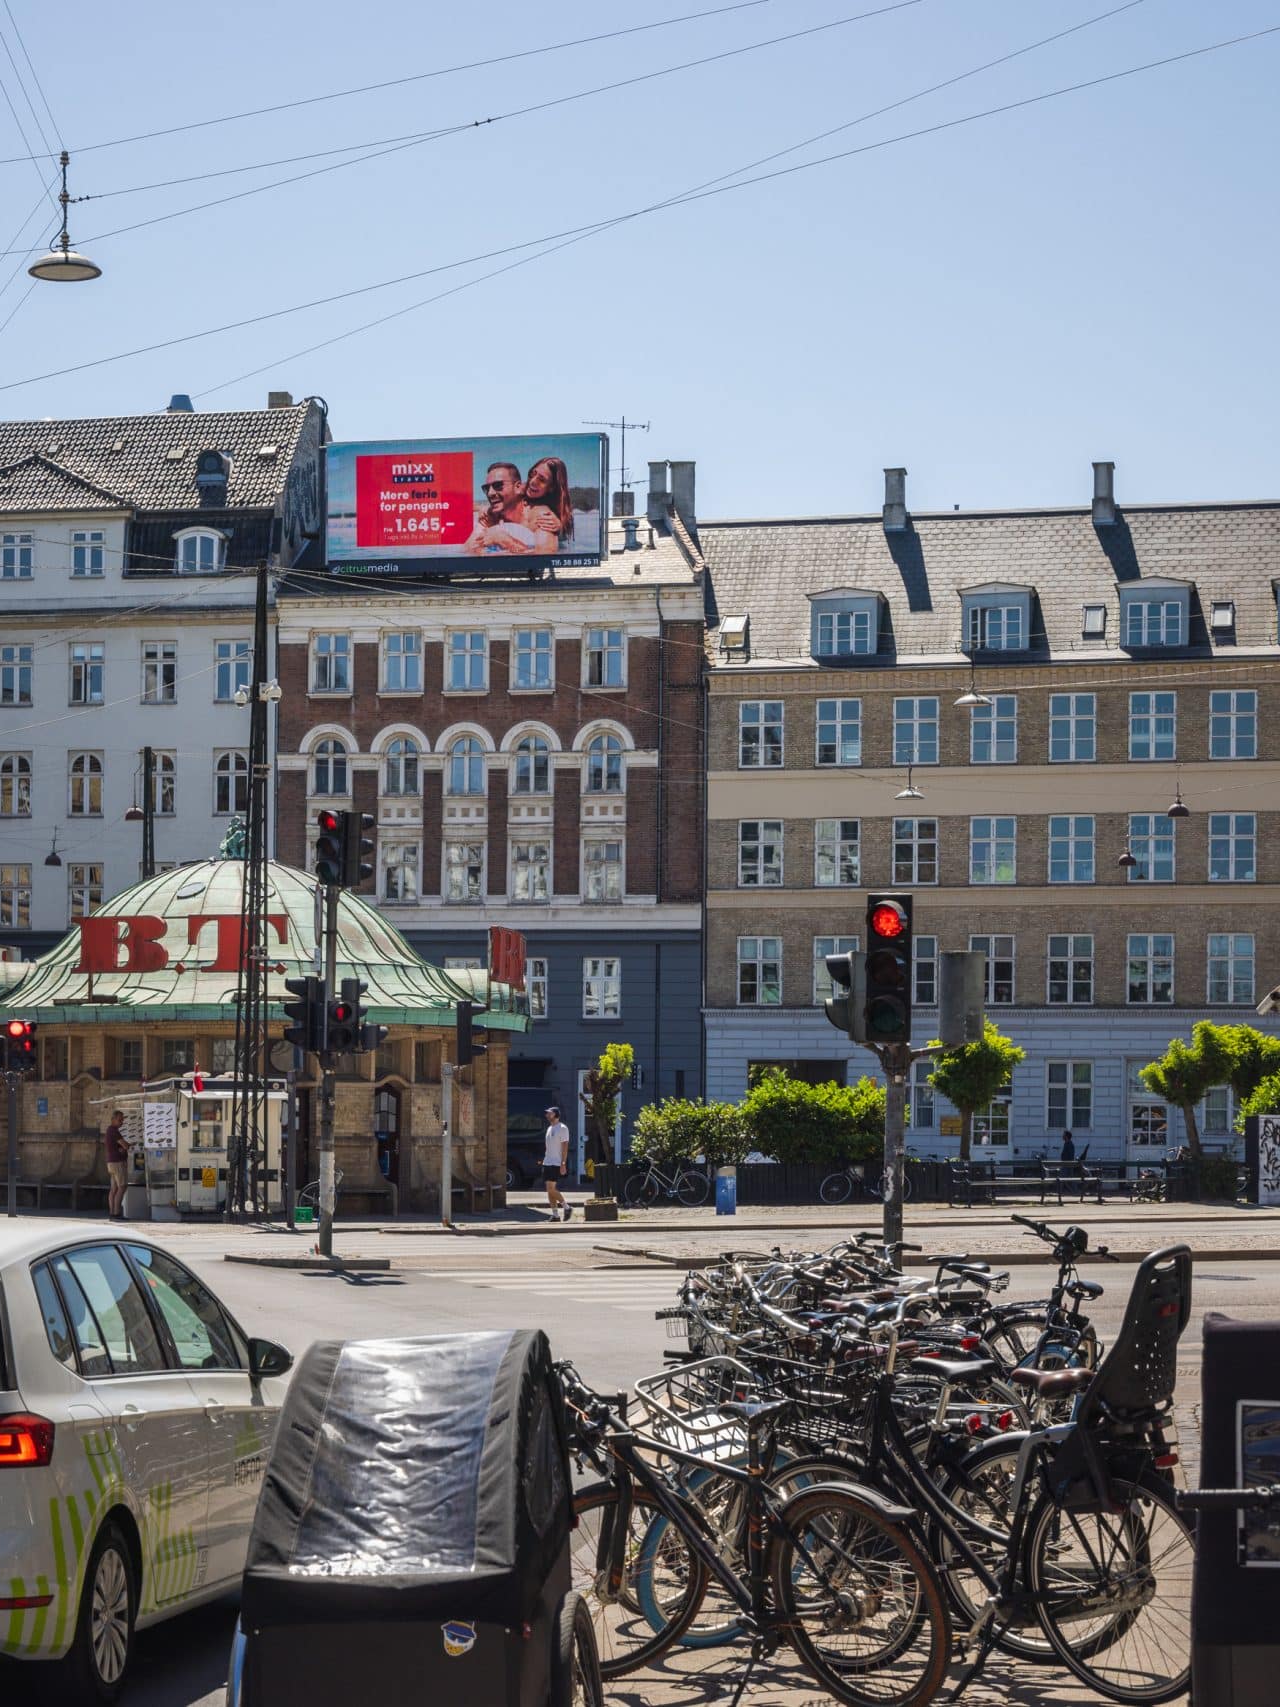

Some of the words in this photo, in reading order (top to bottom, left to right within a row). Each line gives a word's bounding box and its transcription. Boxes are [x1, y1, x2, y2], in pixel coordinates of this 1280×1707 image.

[392, 460, 434, 475] mixx
[394, 475, 432, 483] travel
[380, 491, 409, 500] Mere
[411, 489, 437, 499] ferie
[380, 502, 397, 511] for
[399, 502, 449, 513] pengene
[340, 563, 399, 573] citrusmedia
